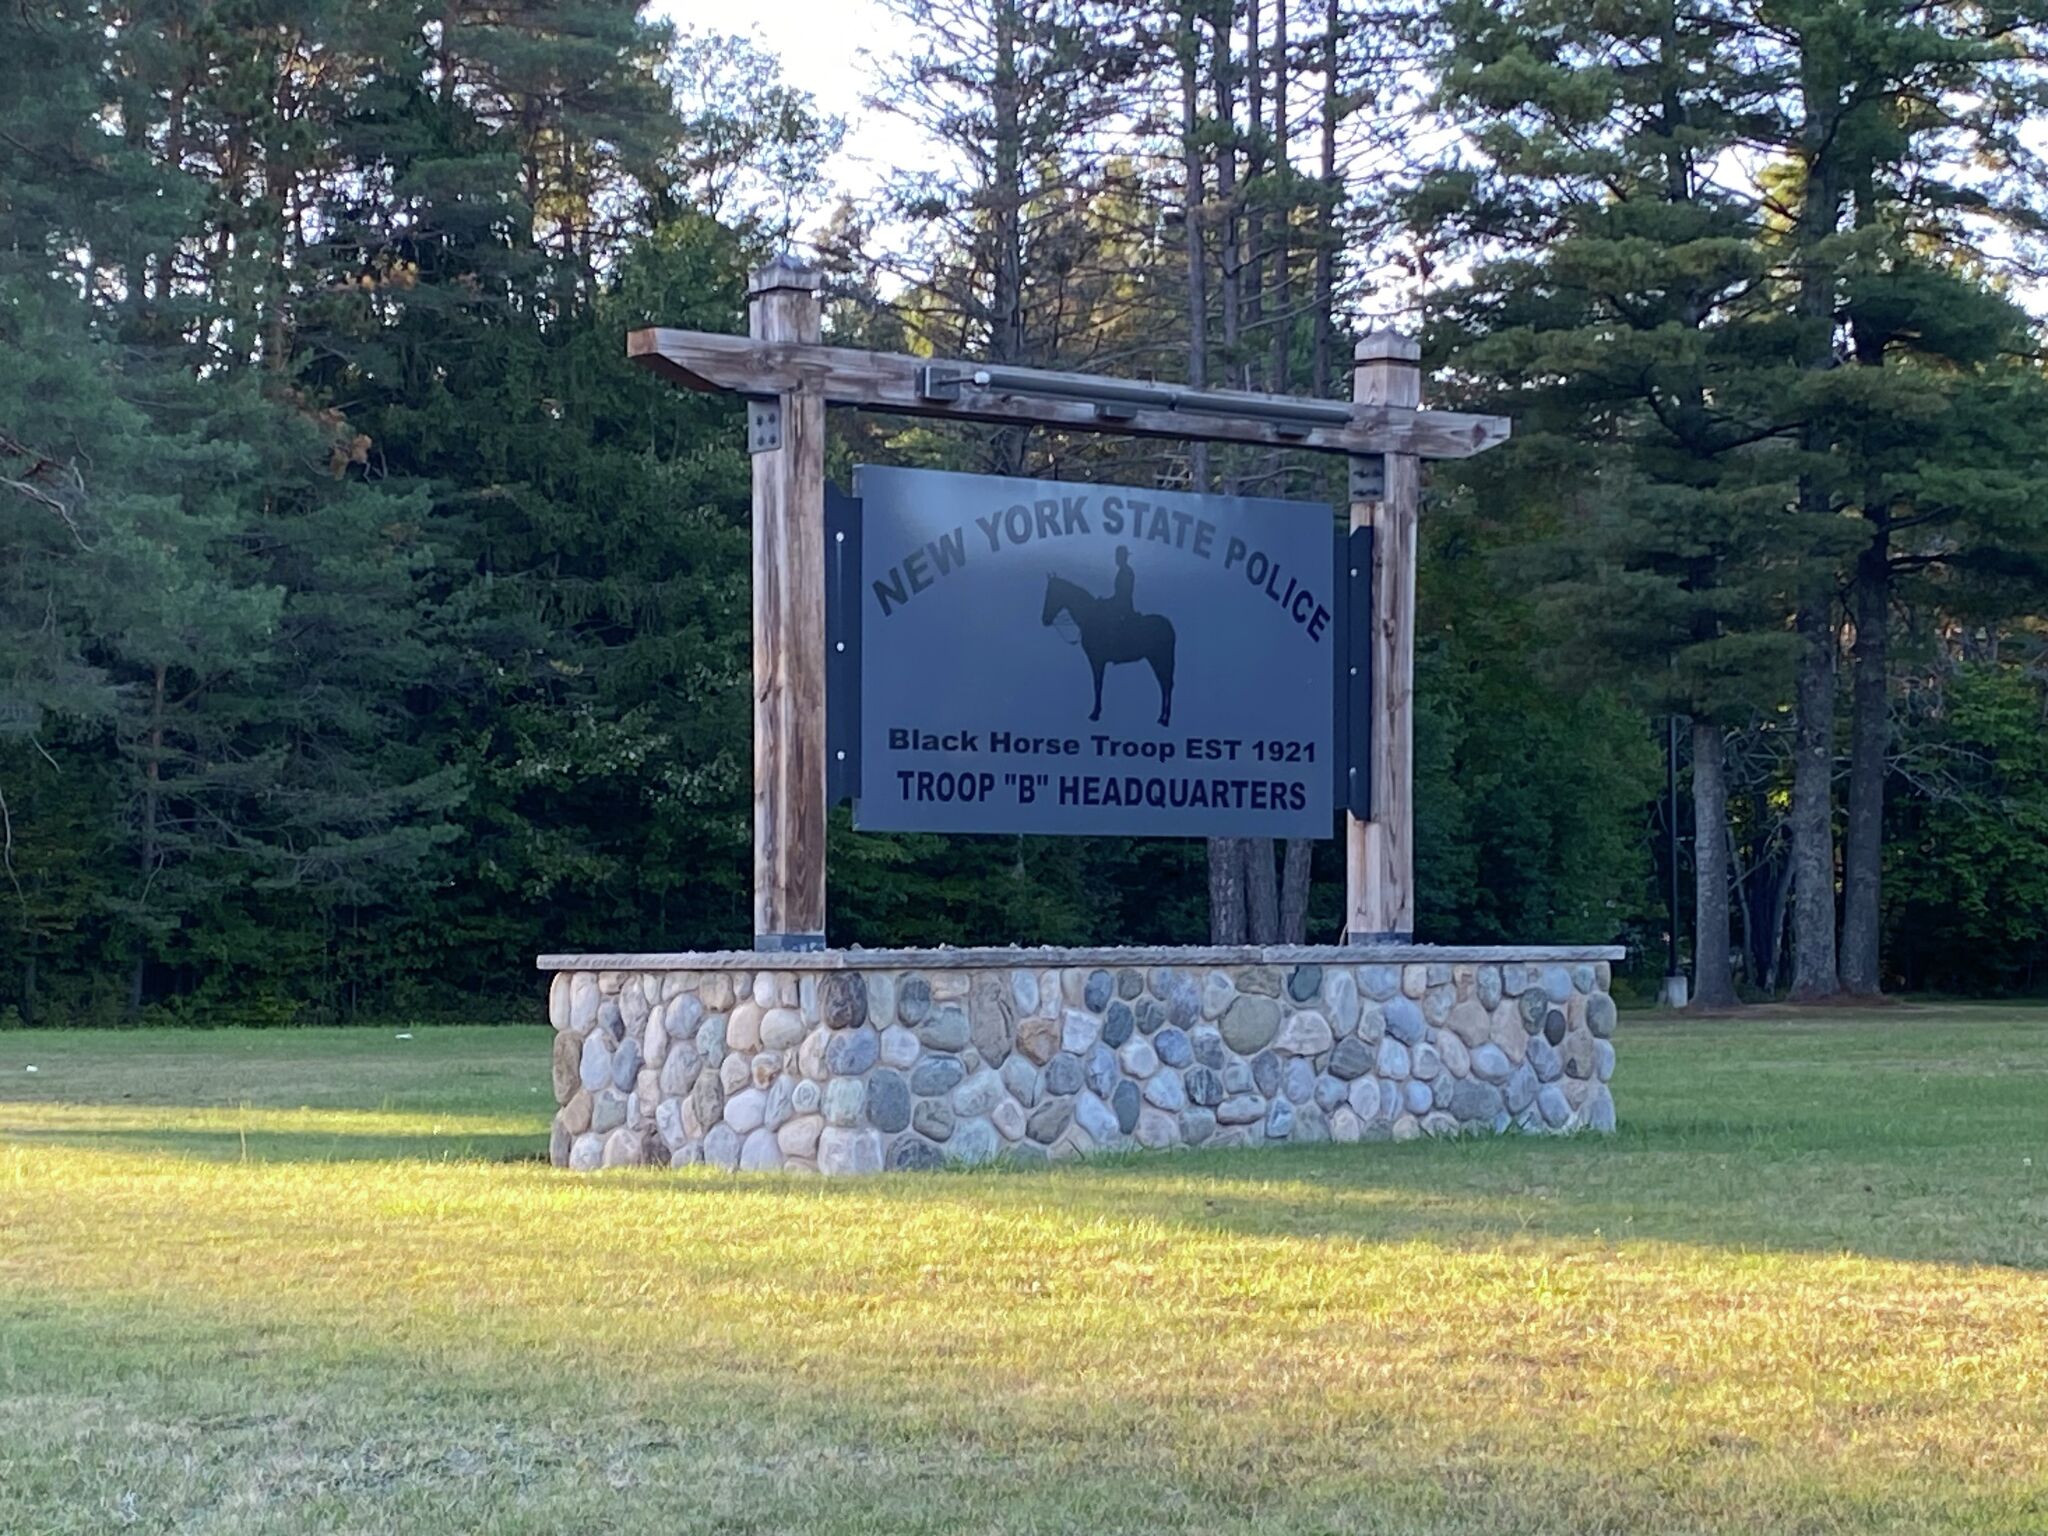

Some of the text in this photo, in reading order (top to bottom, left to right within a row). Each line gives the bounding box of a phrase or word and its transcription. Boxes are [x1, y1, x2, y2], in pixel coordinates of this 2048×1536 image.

[872, 496, 1331, 643] NEW YORK STATE POLICE
[888, 728, 1315, 763] Black Horse Troop EST 1921
[897, 770, 1306, 811] TROOP "B" HEADQUARTERS
